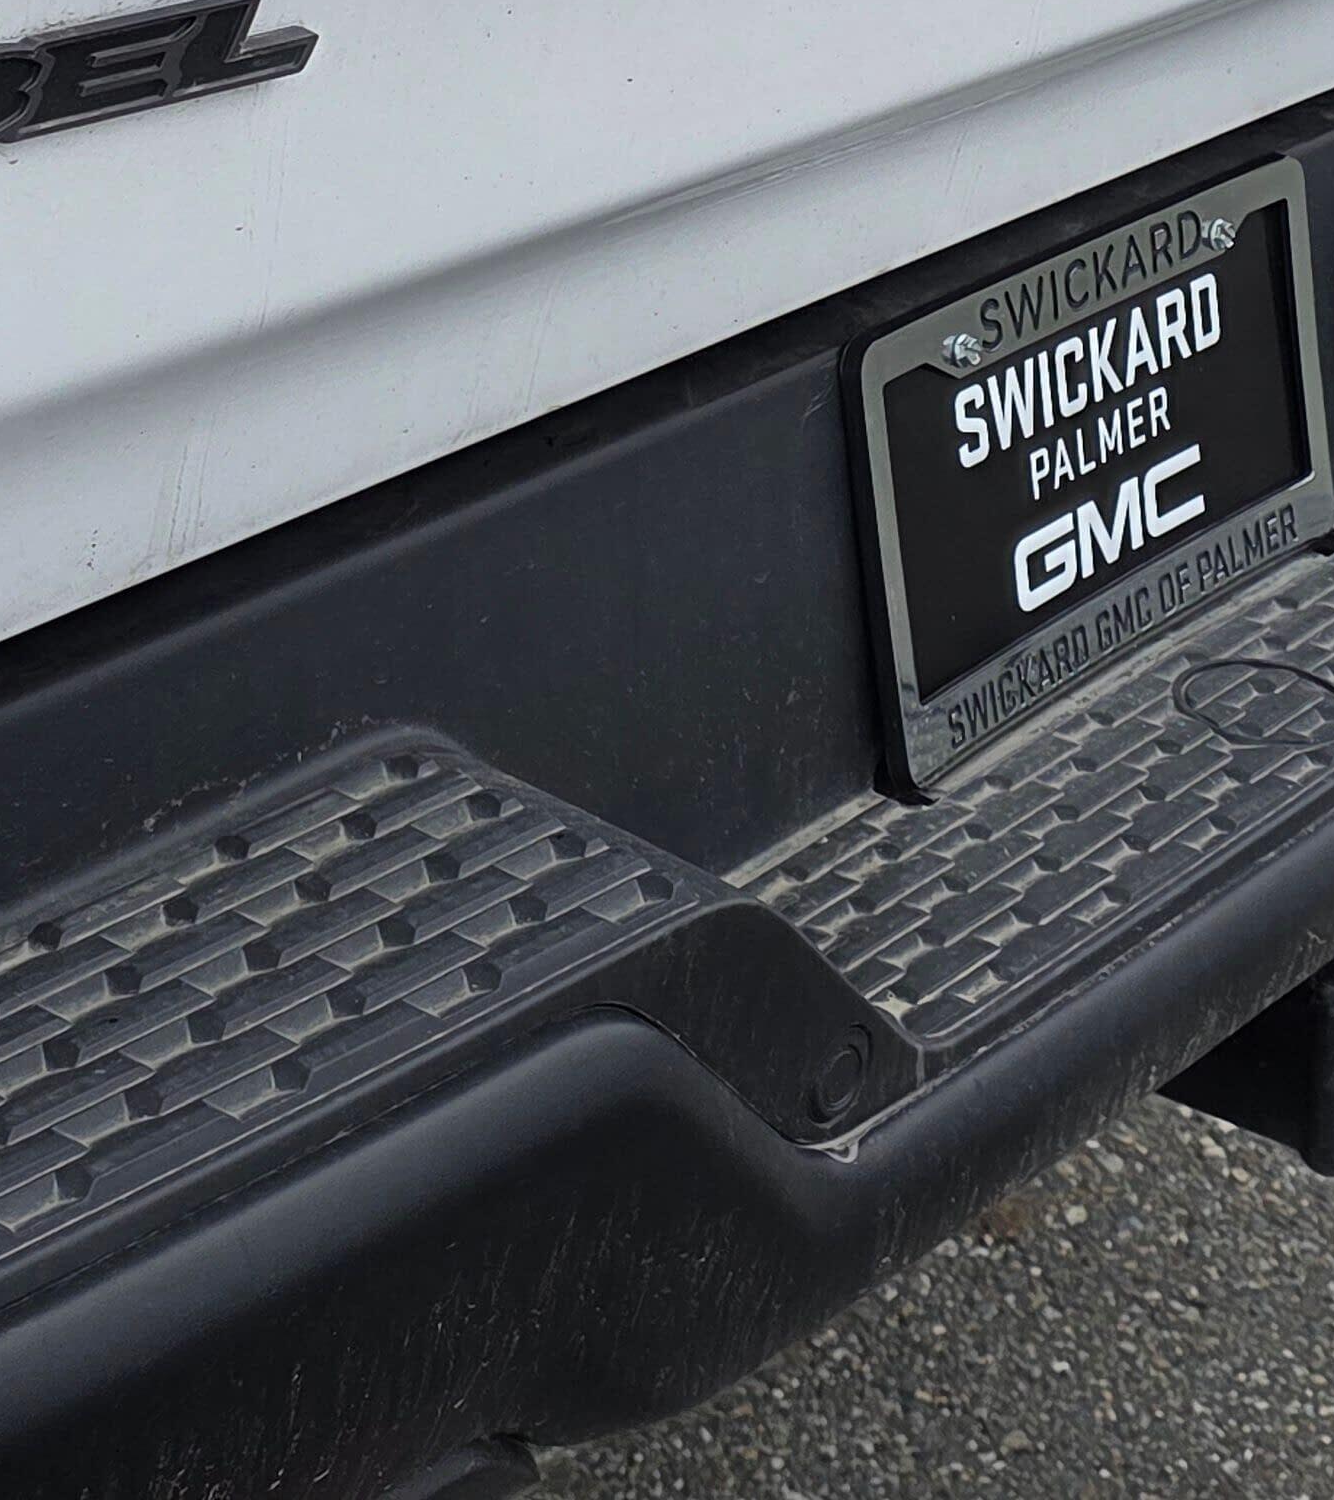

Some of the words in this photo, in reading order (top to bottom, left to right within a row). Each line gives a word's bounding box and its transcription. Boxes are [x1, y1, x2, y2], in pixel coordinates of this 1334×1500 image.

[980, 210, 1202, 349] SWICKARD
[954, 273, 1220, 468] SWICKARD
[1029, 386, 1171, 500] PALMER
[1014, 444, 1205, 612] GMC
[947, 625, 1090, 749] SWICKARD
[1096, 587, 1153, 653] GMC
[1158, 568, 1191, 615] OF
[1196, 503, 1299, 593] PALMER
